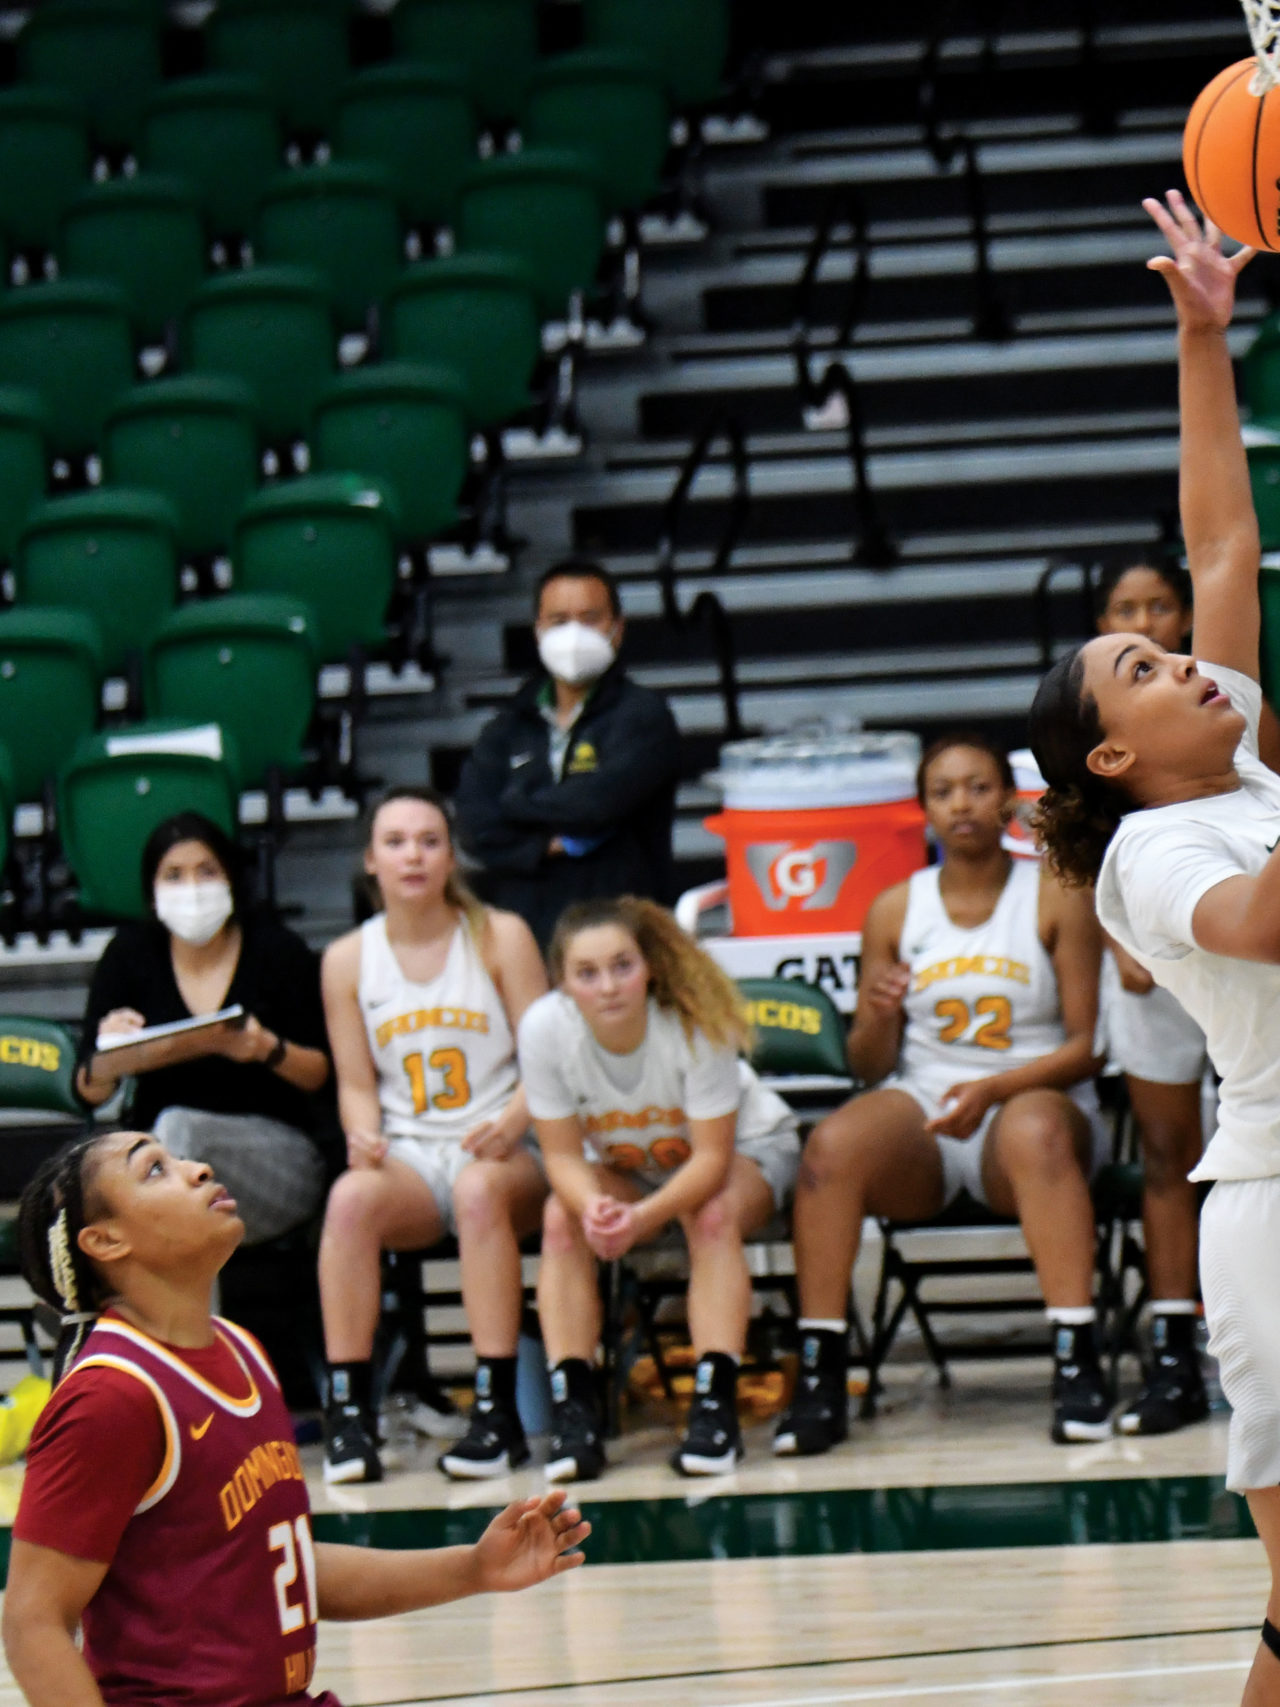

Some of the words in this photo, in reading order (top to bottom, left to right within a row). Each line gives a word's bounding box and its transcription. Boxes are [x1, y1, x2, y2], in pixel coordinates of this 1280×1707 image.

[776, 850, 815, 896] G
[934, 995, 1012, 1051] 22
[402, 1046, 471, 1116] 13
[268, 1514, 318, 1636] 21
